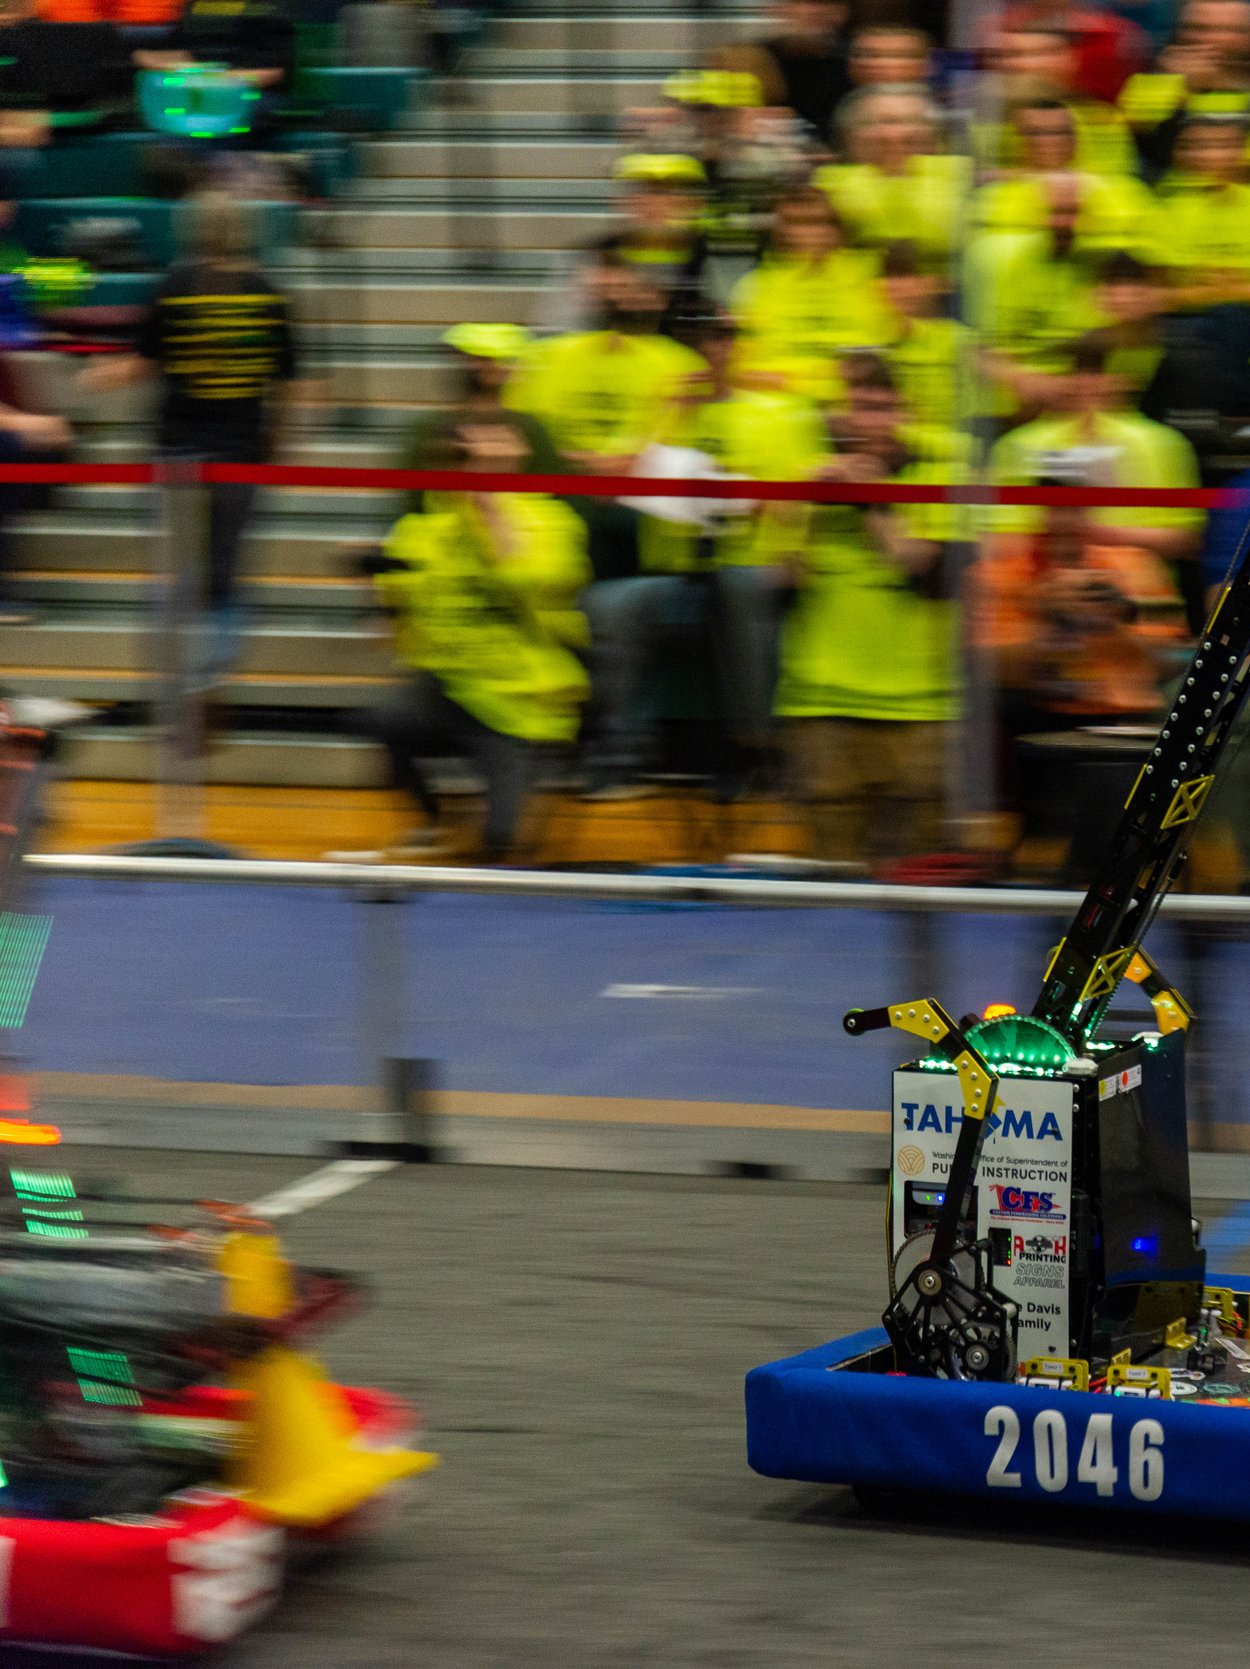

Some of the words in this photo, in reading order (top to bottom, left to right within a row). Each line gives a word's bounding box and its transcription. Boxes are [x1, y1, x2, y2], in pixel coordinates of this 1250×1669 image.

[1006, 1156, 1059, 1167] Superintendent
[982, 1166, 1067, 1182] INSTRUCTION
[1001, 1186, 1053, 1212] CFS
[1019, 1252, 1066, 1263] PRINTING
[1015, 1263, 1065, 1278] SIGNS
[1013, 1276, 1066, 1289] APPAREL
[1027, 1302, 1062, 1315] Davis
[1018, 1318, 1051, 1332] amily
[984, 1405, 1165, 1501] 2046
